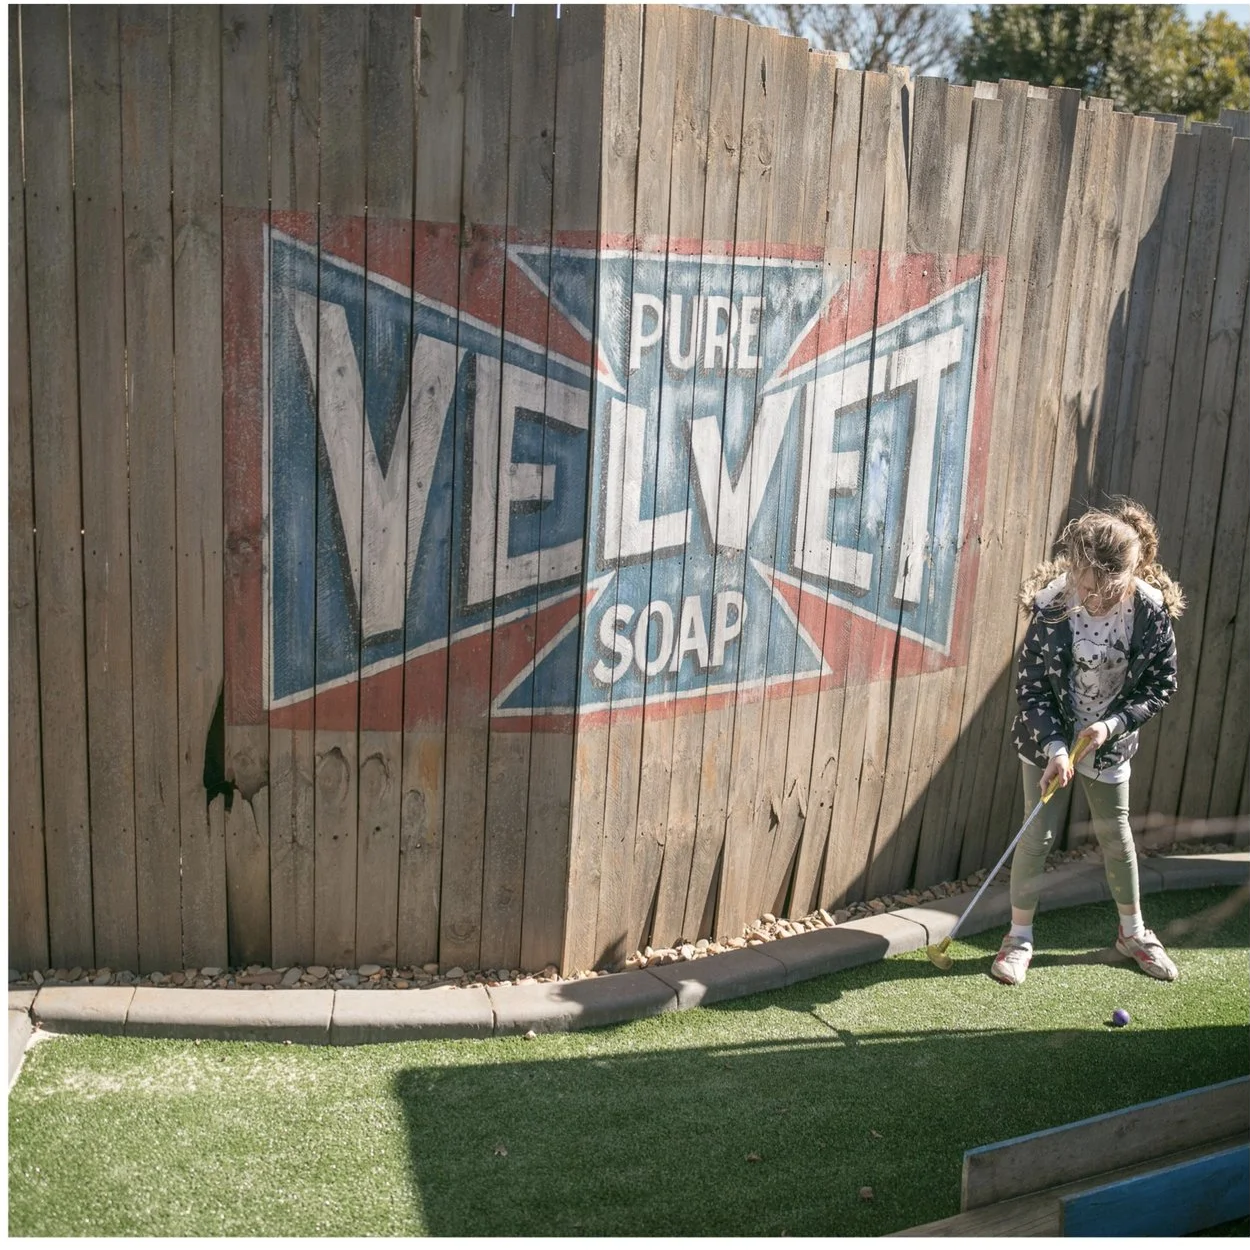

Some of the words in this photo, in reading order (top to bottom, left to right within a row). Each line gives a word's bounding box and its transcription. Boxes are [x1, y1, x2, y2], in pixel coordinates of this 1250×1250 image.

[627, 293, 764, 378] PURE
[292, 291, 965, 640] VELVET
[590, 591, 751, 685] SOAP
